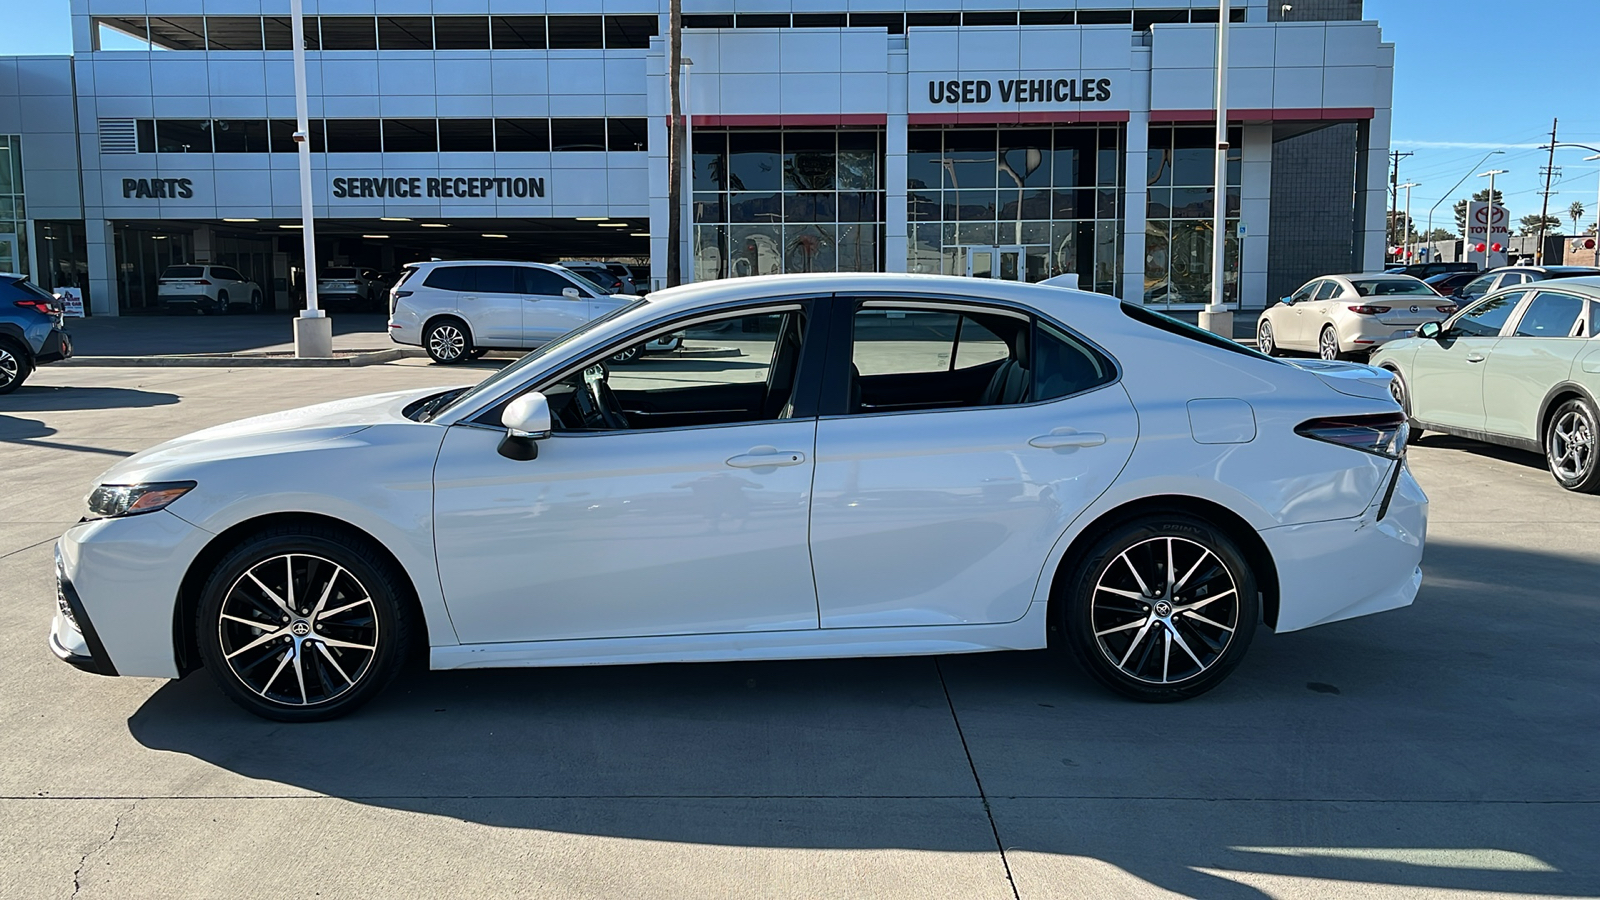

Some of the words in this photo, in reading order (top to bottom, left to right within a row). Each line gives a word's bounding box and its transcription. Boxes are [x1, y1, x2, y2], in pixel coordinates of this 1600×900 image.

[929, 80, 992, 104] USED
[998, 78, 1111, 103] VEHICLES
[122, 178, 193, 199] PARTS
[333, 177, 421, 198] SERVICE
[426, 177, 545, 198] RECEPTION
